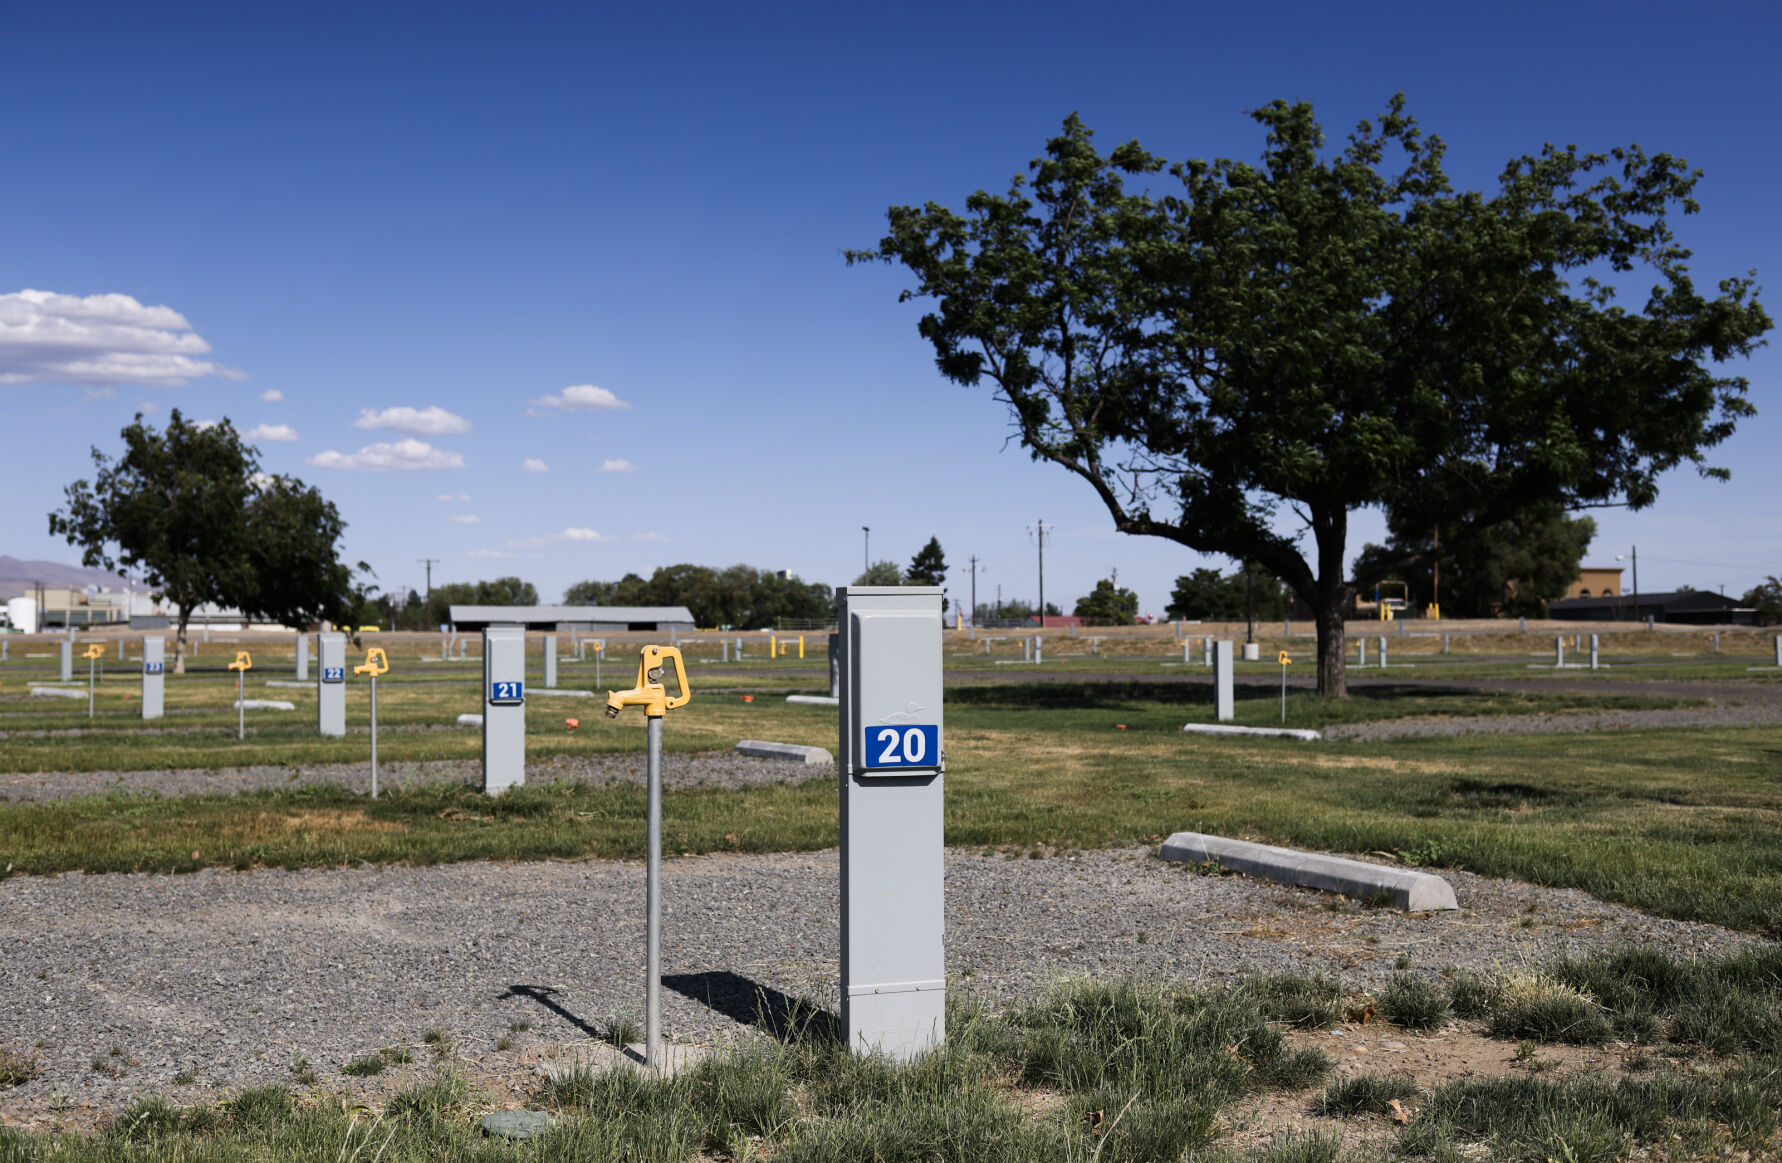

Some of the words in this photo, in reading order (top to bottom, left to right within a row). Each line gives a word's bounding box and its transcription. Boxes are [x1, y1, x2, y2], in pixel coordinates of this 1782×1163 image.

[327, 668, 341, 678] 22
[498, 683, 517, 698] 21
[877, 728, 926, 763] 20
